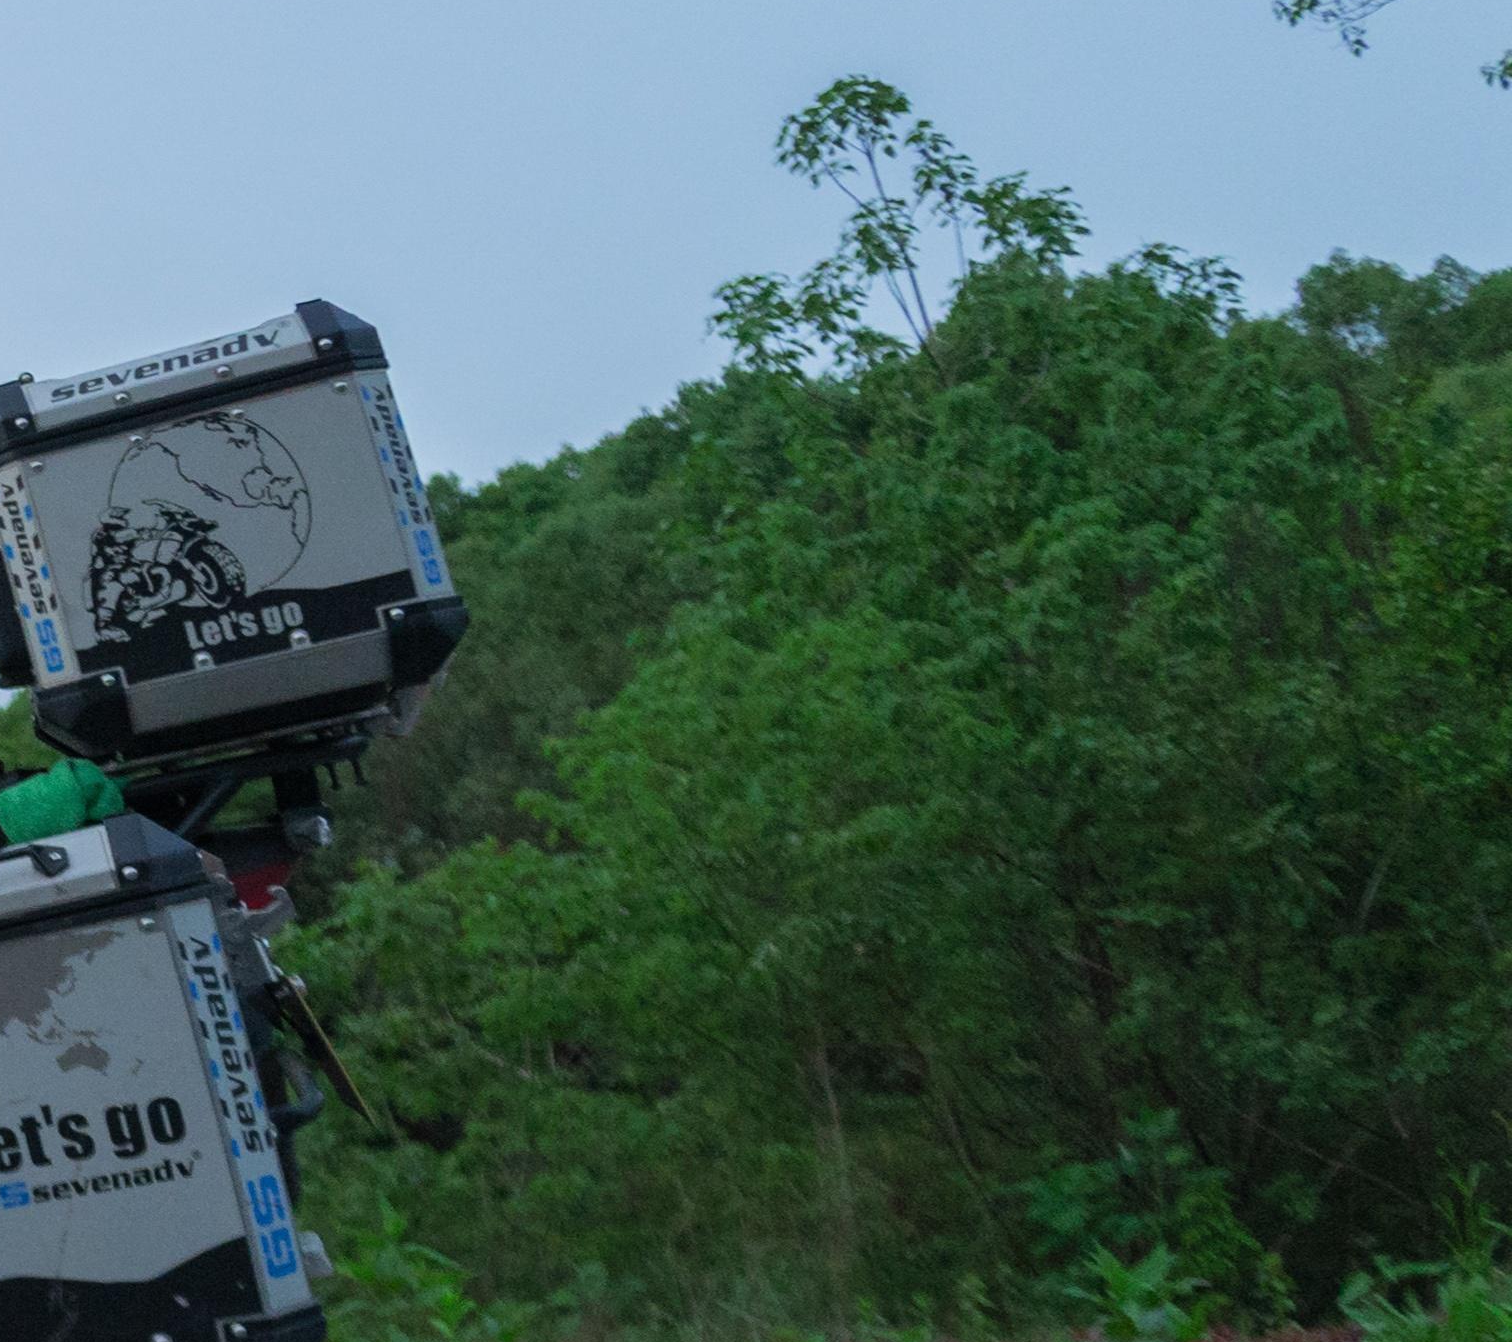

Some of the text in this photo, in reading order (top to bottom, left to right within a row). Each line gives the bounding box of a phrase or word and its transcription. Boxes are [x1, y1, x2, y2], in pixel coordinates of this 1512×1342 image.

[50, 330, 280, 403] sevenadv
[1, 483, 64, 673] GS sevenadv
[184, 601, 304, 650] Let's go
[105, 1096, 186, 1159] go
[189, 935, 297, 1280] GS sevenadv
